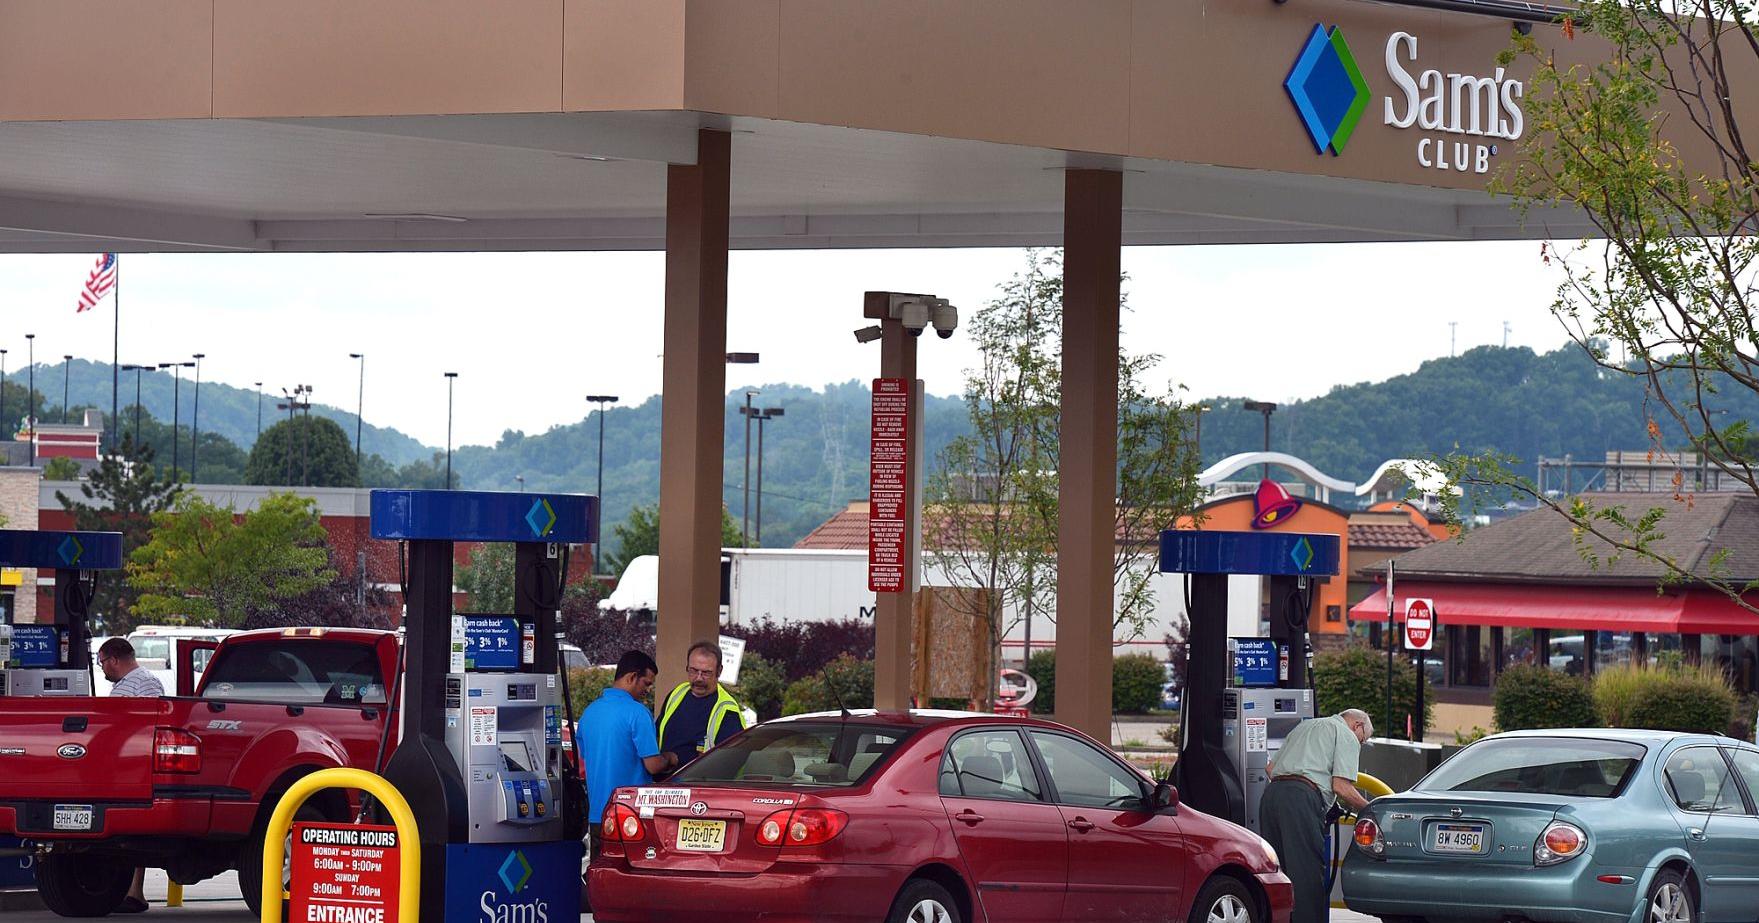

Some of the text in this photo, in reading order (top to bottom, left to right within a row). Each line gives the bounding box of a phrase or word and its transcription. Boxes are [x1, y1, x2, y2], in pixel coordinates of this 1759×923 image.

[1384, 31, 1524, 142] Sam's
[1417, 138, 1490, 173] CLUB
[550, 542, 556, 556] 6
[1409, 608, 1429, 618] DO NOT
[476, 619, 488, 627] cash
[1410, 629, 1427, 639] ENTER
[24, 641, 34, 650] 3%
[38, 641, 48, 650] 1%
[479, 636, 491, 648] 3%
[497, 636, 508, 648] 1%
[1246, 657, 1256, 667] 3%
[1259, 657, 1268, 667] 1%
[207, 719, 243, 731] STX
[648, 794, 689, 806] WASHINGTON
[55, 812, 90, 825] 5HH 428
[302, 828, 396, 846] OPERATING HOURS
[1438, 832, 1479, 846] 8W 4960
[312, 847, 340, 856] MONDAY
[351, 849, 384, 858] SATURDAY
[313, 858, 343, 870] 6:00AM
[351, 860, 382, 872] 9:00PM
[334, 873, 360, 882] SUNDAY
[312, 882, 381, 897] 9:00AM 7:00PM
[480, 890, 549, 923] Sam's
[307, 904, 385, 923] ENTRANCE
